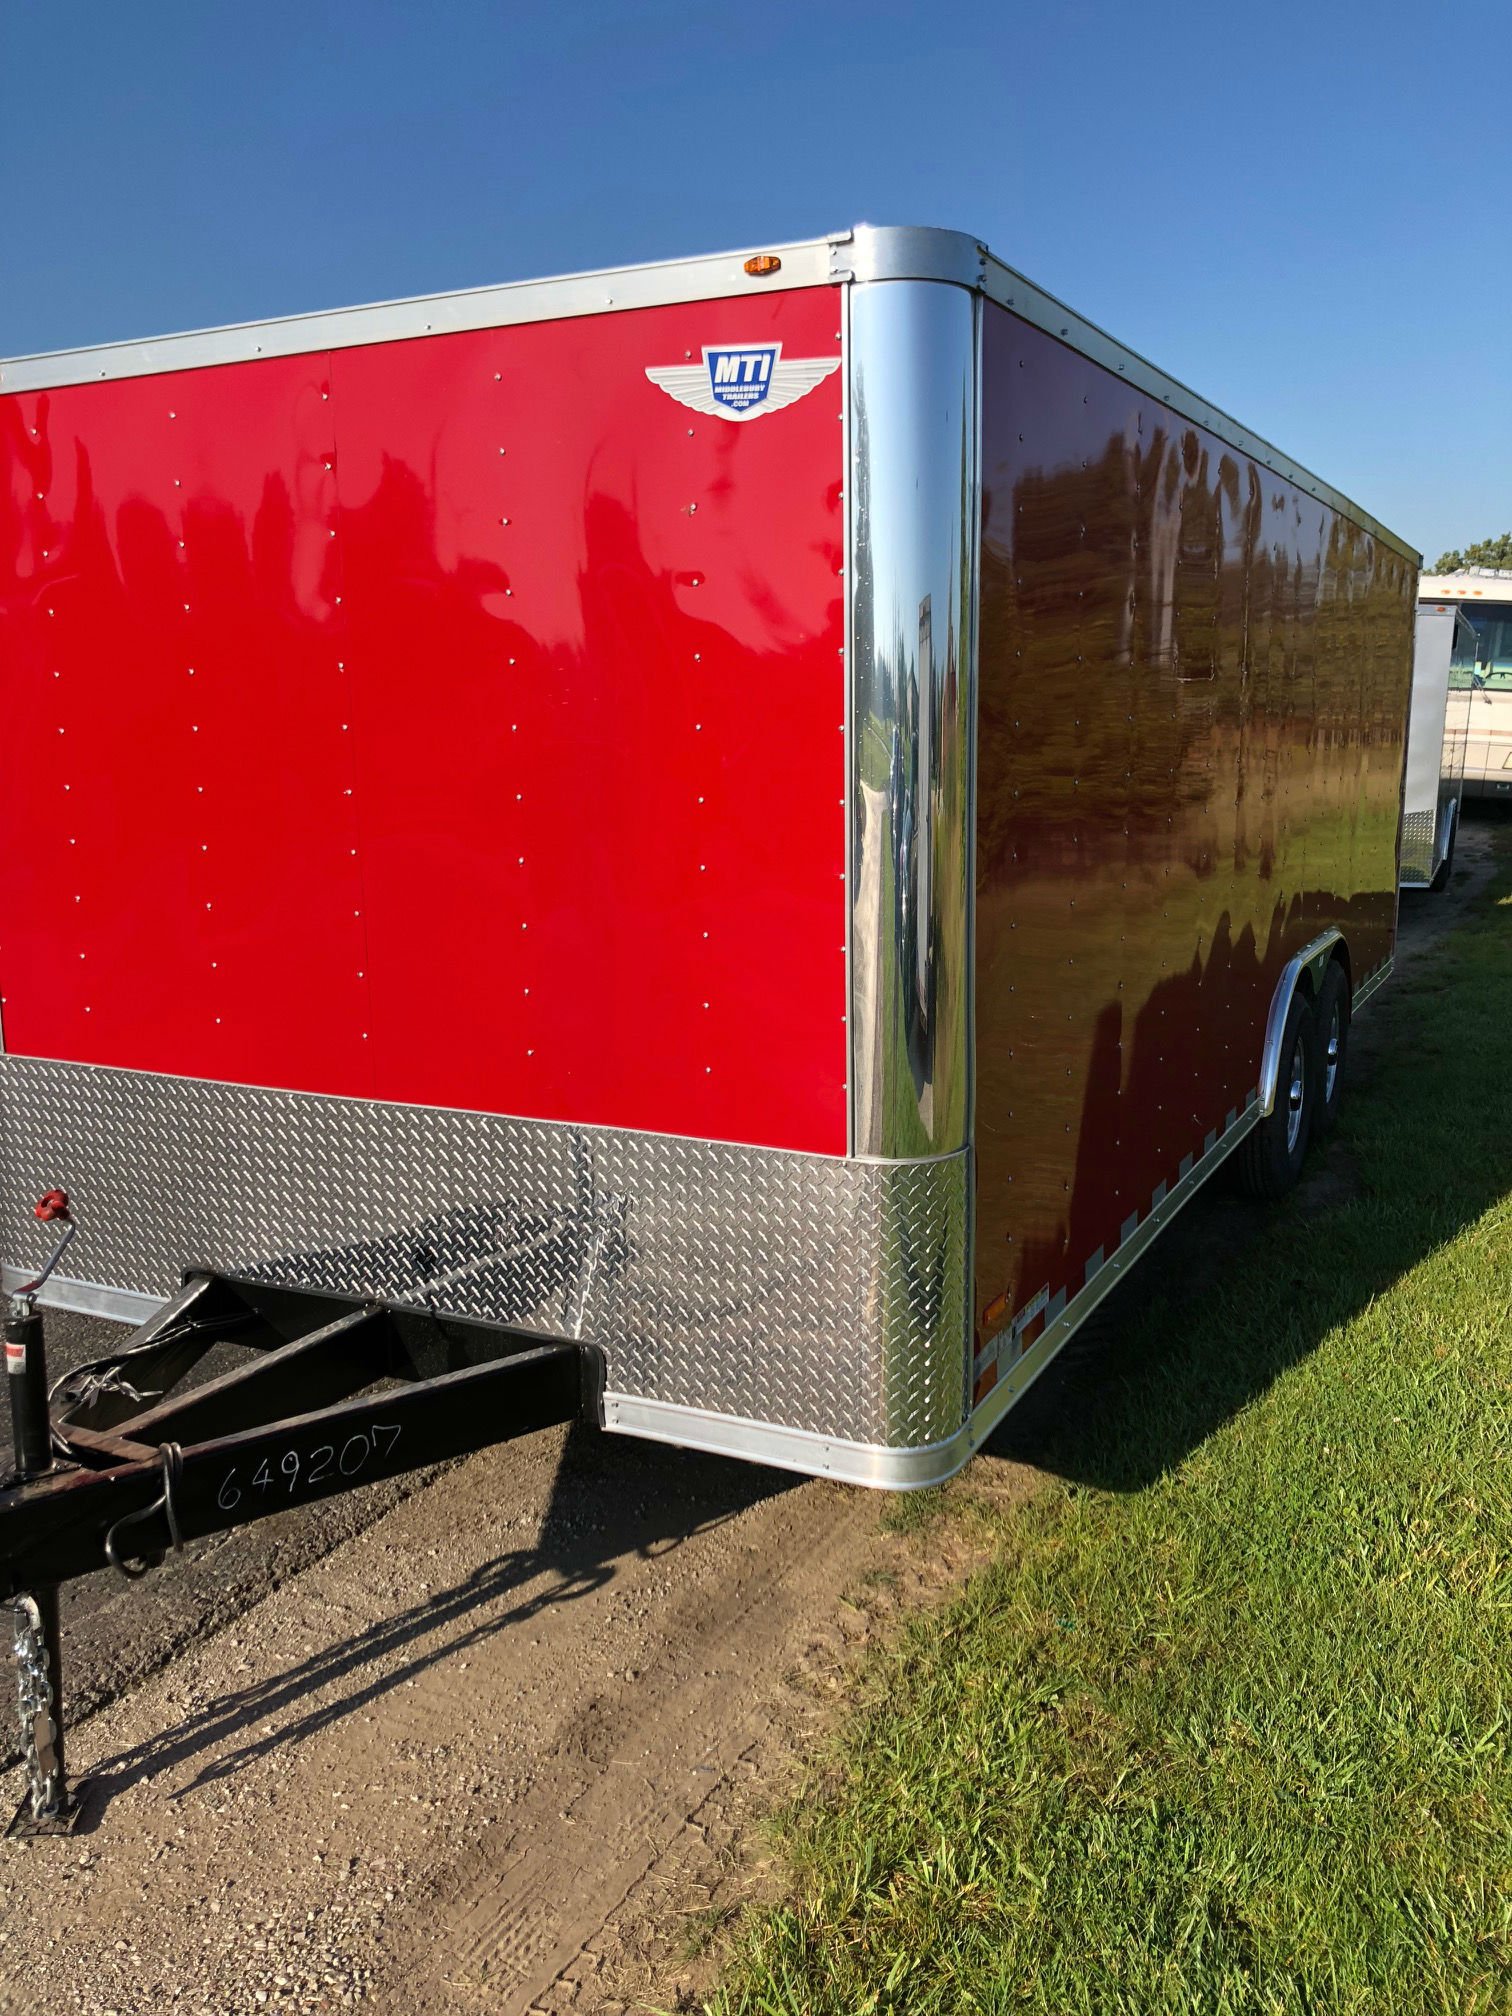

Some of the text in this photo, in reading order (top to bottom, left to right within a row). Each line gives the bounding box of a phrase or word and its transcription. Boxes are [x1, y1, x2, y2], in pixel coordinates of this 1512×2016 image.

[714, 354, 771, 383] MTI
[714, 384, 765, 393] MIDDLEBURY
[723, 392, 759, 400] TRAILERS
[217, 1425, 401, 1510] 649207
